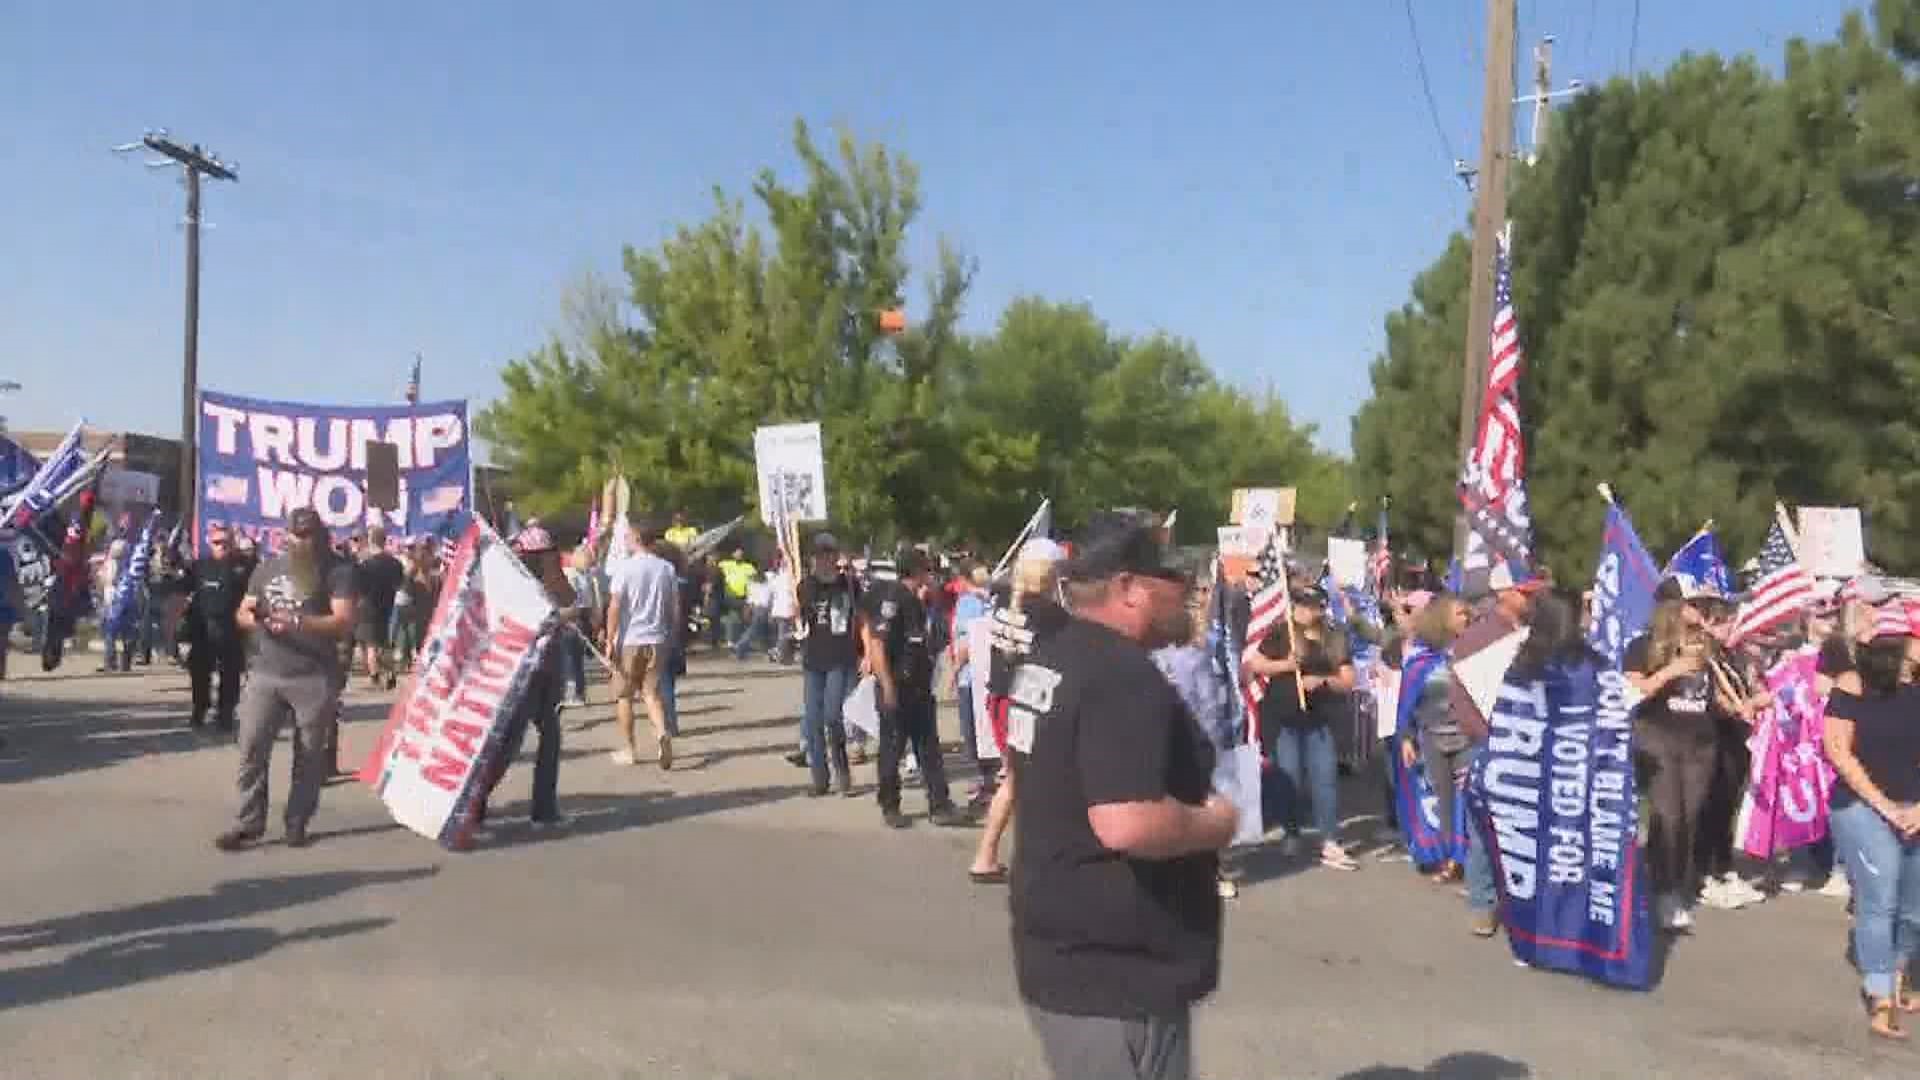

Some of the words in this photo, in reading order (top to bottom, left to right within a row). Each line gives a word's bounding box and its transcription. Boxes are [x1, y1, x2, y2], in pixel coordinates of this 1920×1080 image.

[203, 401, 463, 472] TRUMP
[420, 615, 537, 792] NATION
[1559, 704, 1593, 714] I
[1596, 670, 1631, 762] DON'T
[1483, 680, 1549, 901] TRUMP
[1551, 722, 1593, 818] VOTED
[1548, 826, 1585, 885] FOR
[1589, 770, 1624, 871] BLAME
[1588, 878, 1617, 927] ME
